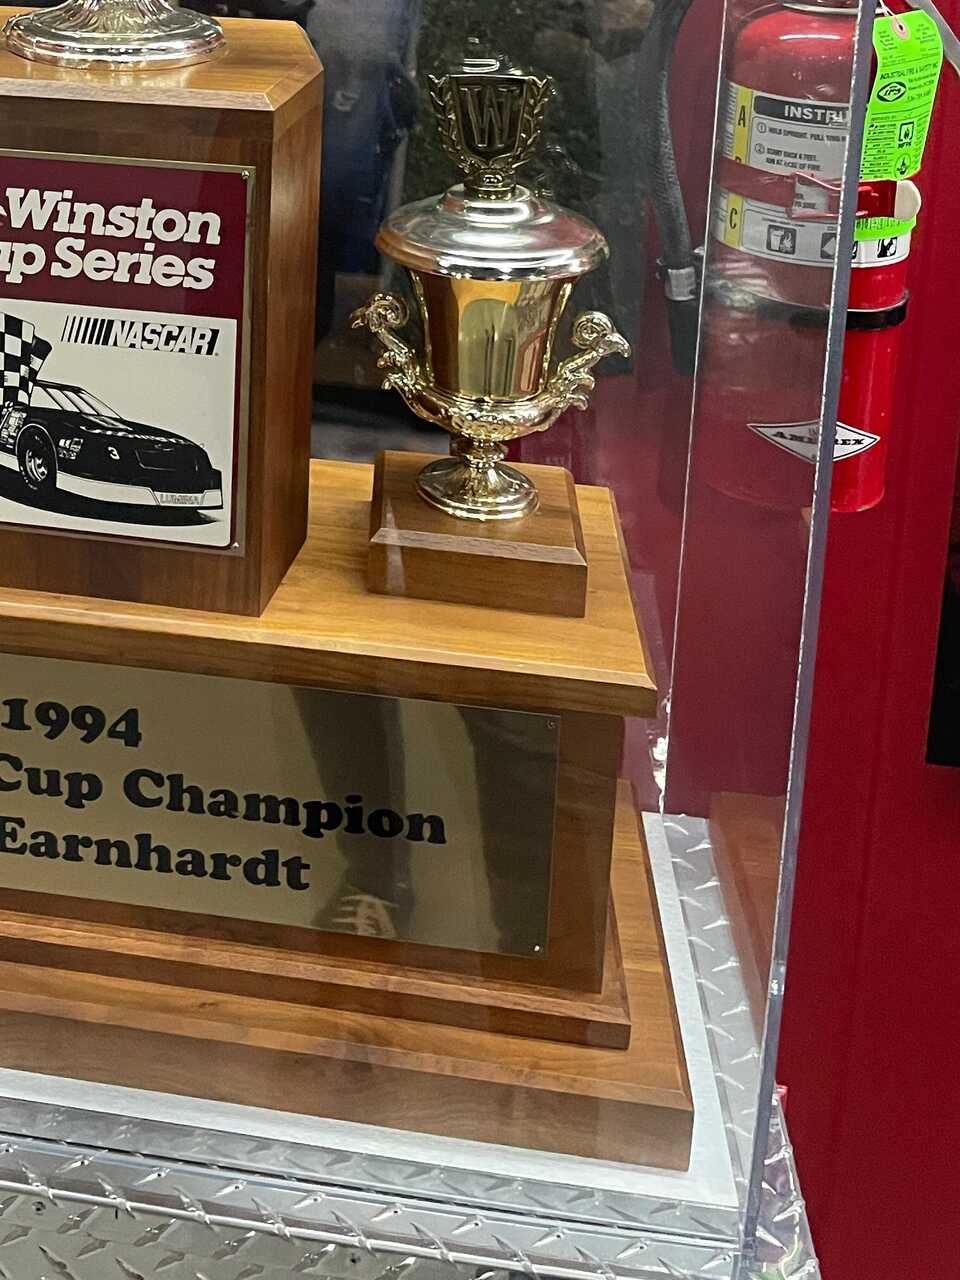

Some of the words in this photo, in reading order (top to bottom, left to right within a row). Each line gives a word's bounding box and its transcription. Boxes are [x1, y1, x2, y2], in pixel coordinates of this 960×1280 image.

[6, 187, 221, 246] Winston
[50, 238, 216, 291] Series
[109, 319, 212, 356] NASCAR
[107, 446, 120, 460] 3
[0, 696, 142, 748] 1994
[122, 768, 448, 846] Champion
